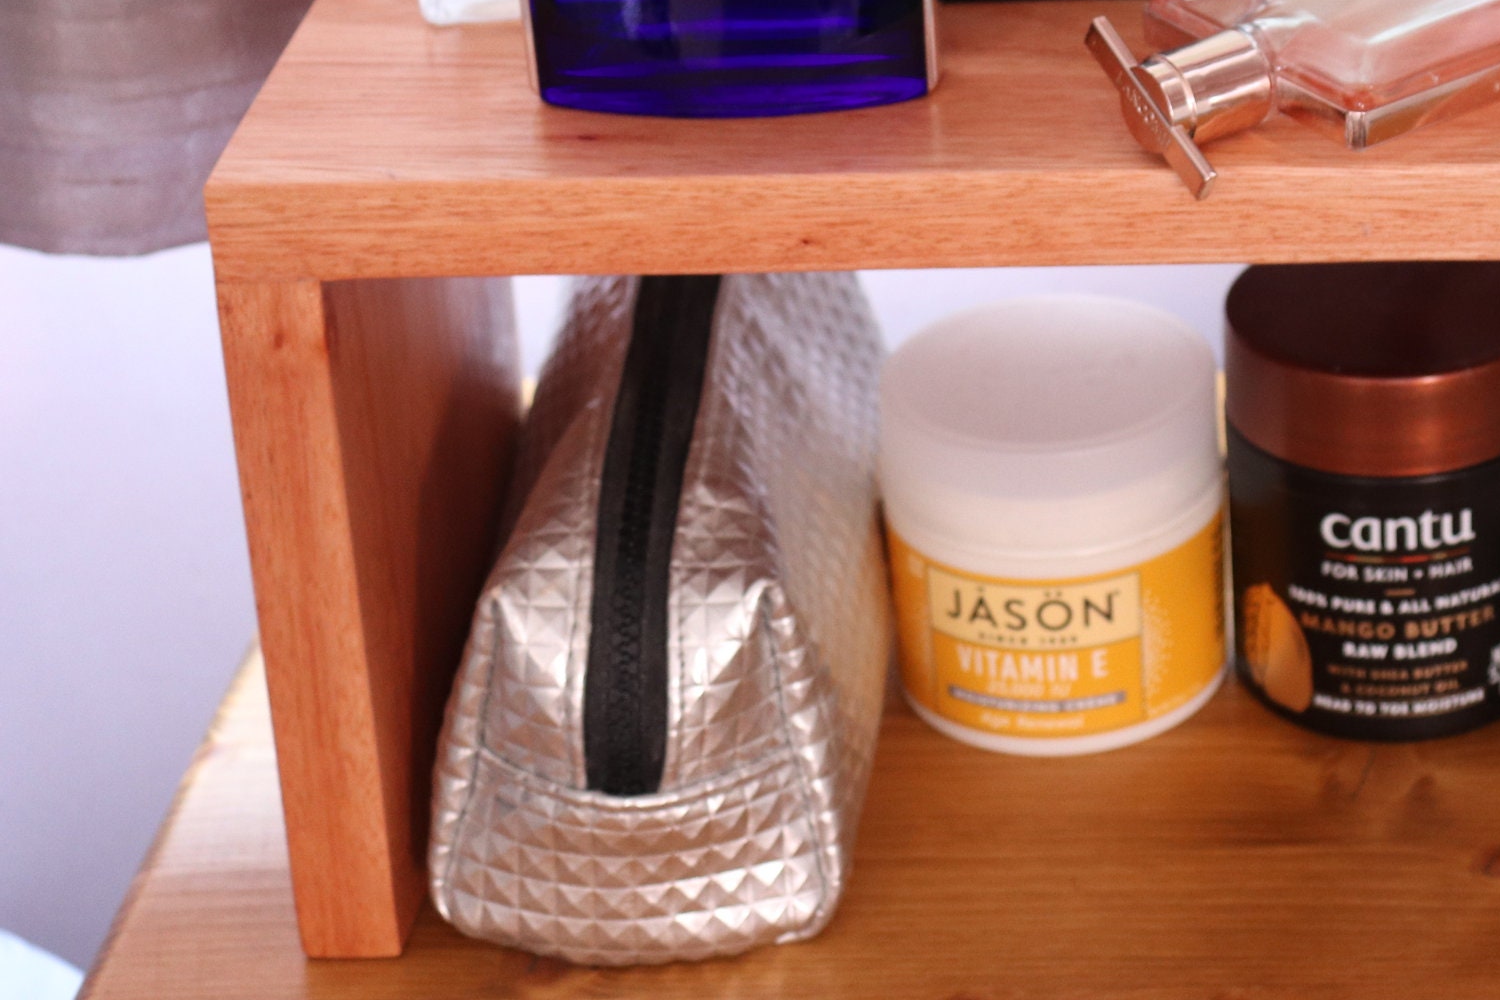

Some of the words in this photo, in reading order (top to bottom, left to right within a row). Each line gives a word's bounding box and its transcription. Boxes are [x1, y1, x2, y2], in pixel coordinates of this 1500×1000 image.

[1320, 508, 1477, 551] cantu
[1321, 560, 1359, 580] FOR
[1363, 565, 1408, 583] SKIN
[1428, 556, 1473, 579] HAIR
[1331, 596, 1376, 616] PURE
[1380, 599, 1394, 616] &
[1398, 597, 1431, 614] ALL
[1301, 611, 1396, 640] MANGO
[1404, 604, 1496, 639] BUTTER
[1342, 641, 1389, 660] RAW
[1393, 637, 1458, 660] BLEND
[955, 644, 1079, 682] VITAMIN
[1091, 648, 1109, 679] E
[1412, 660, 1468, 680] BUTTER
